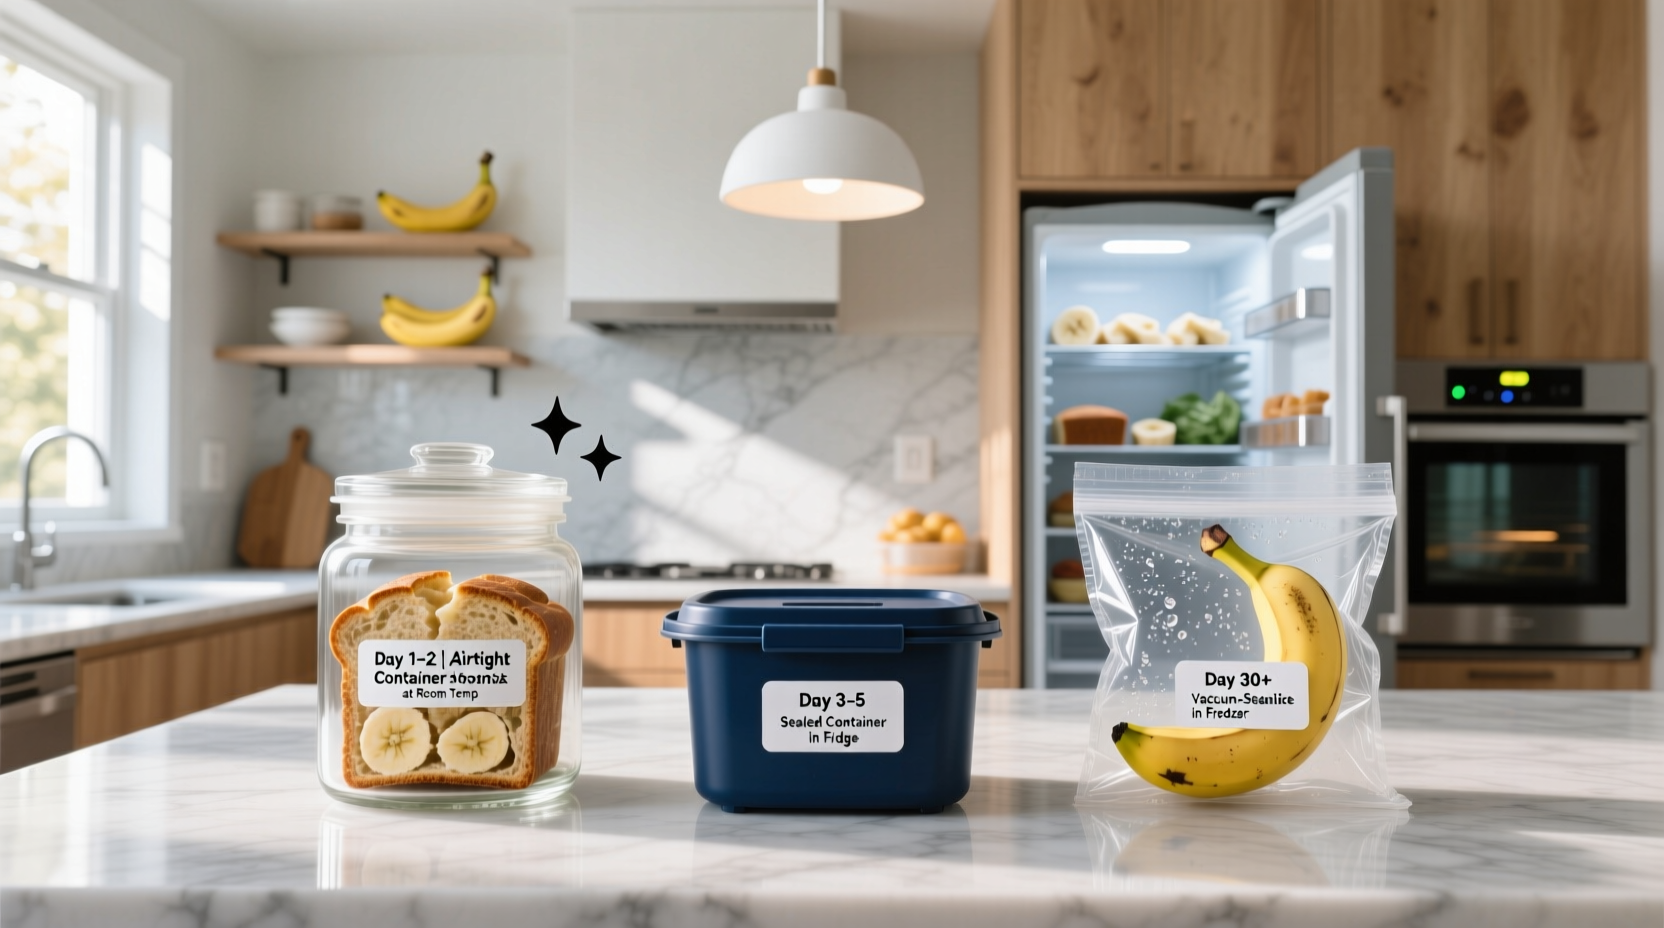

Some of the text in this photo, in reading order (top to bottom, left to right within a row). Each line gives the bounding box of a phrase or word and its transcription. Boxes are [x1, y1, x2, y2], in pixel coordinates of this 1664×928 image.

[374, 649, 404, 670] Day
[449, 650, 511, 671] Airtight
[374, 671, 448, 685] Container
[1205, 672, 1272, 690] Day 30+
[799, 692, 832, 712] Day
[825, 715, 887, 728] Container
